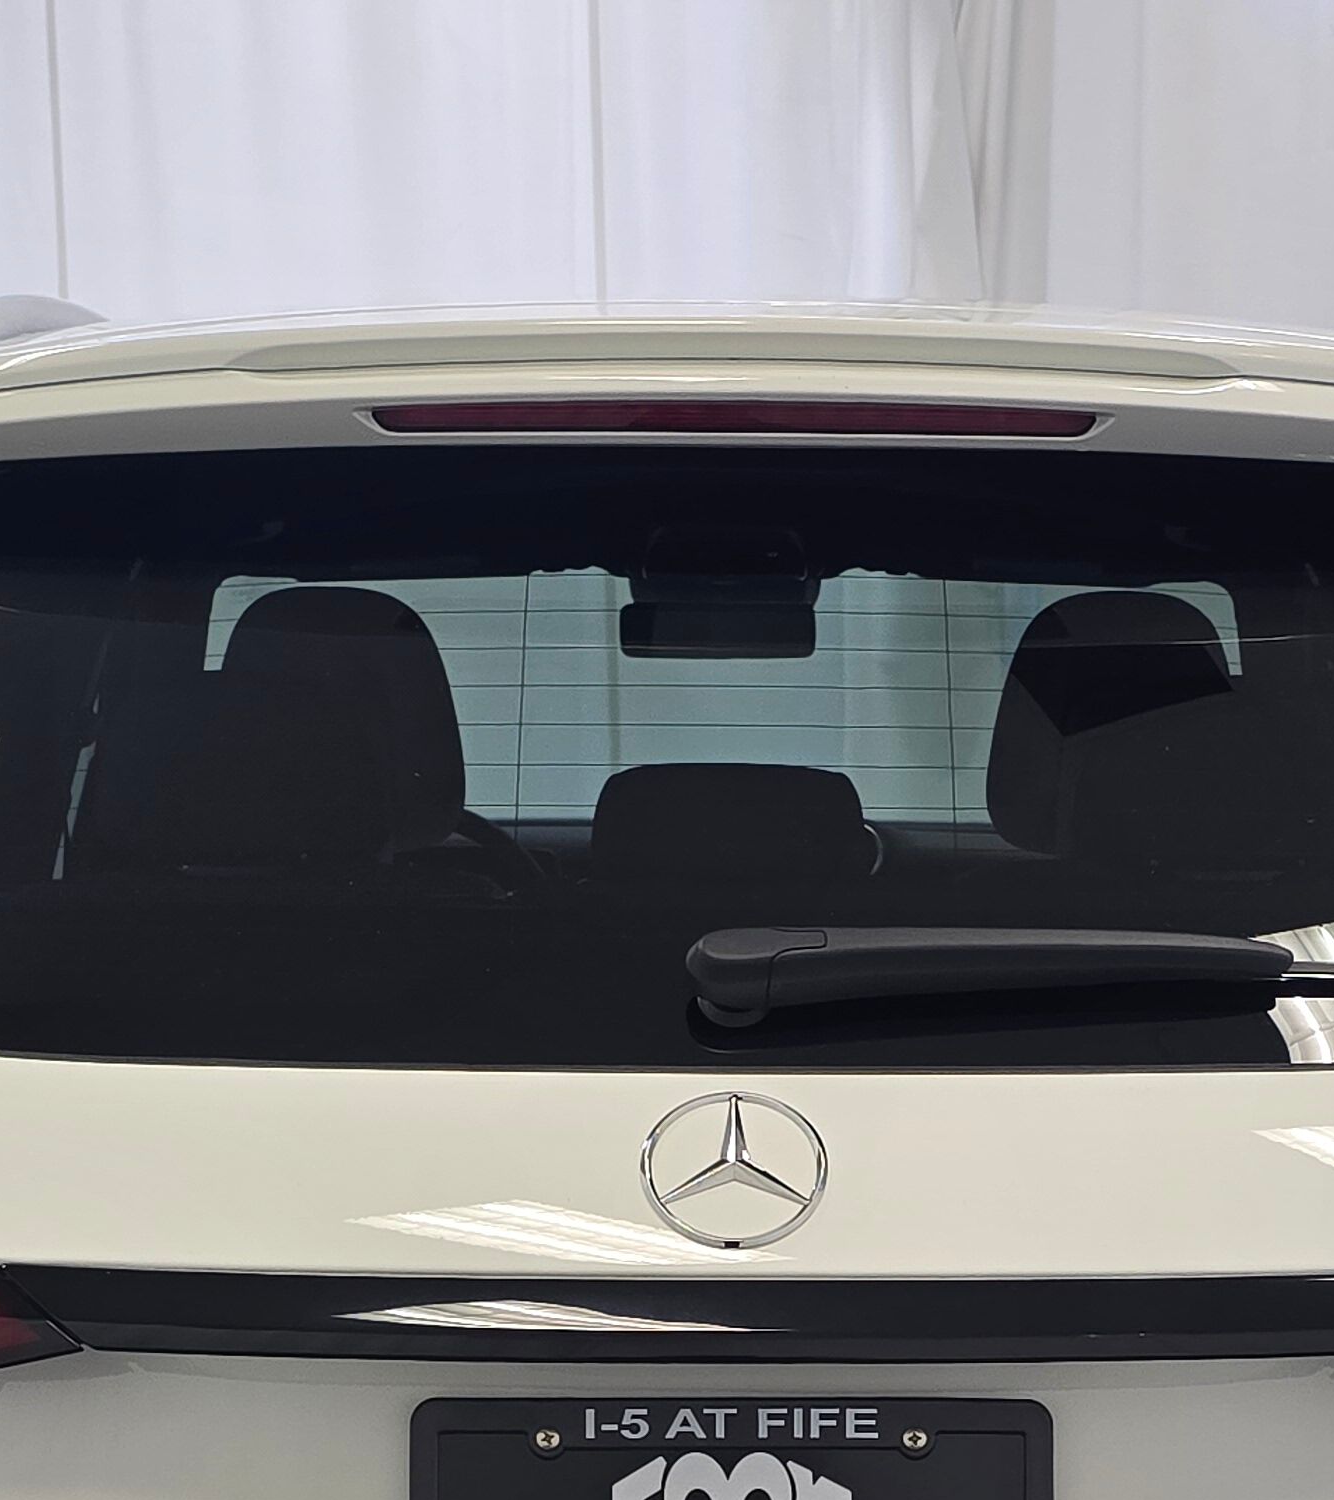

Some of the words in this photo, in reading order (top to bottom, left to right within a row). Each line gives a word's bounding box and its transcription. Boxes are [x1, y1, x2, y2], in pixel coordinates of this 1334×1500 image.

[585, 1408, 650, 1440] I-5
[666, 1408, 738, 1440] AT
[758, 1408, 880, 1440] FIFE
